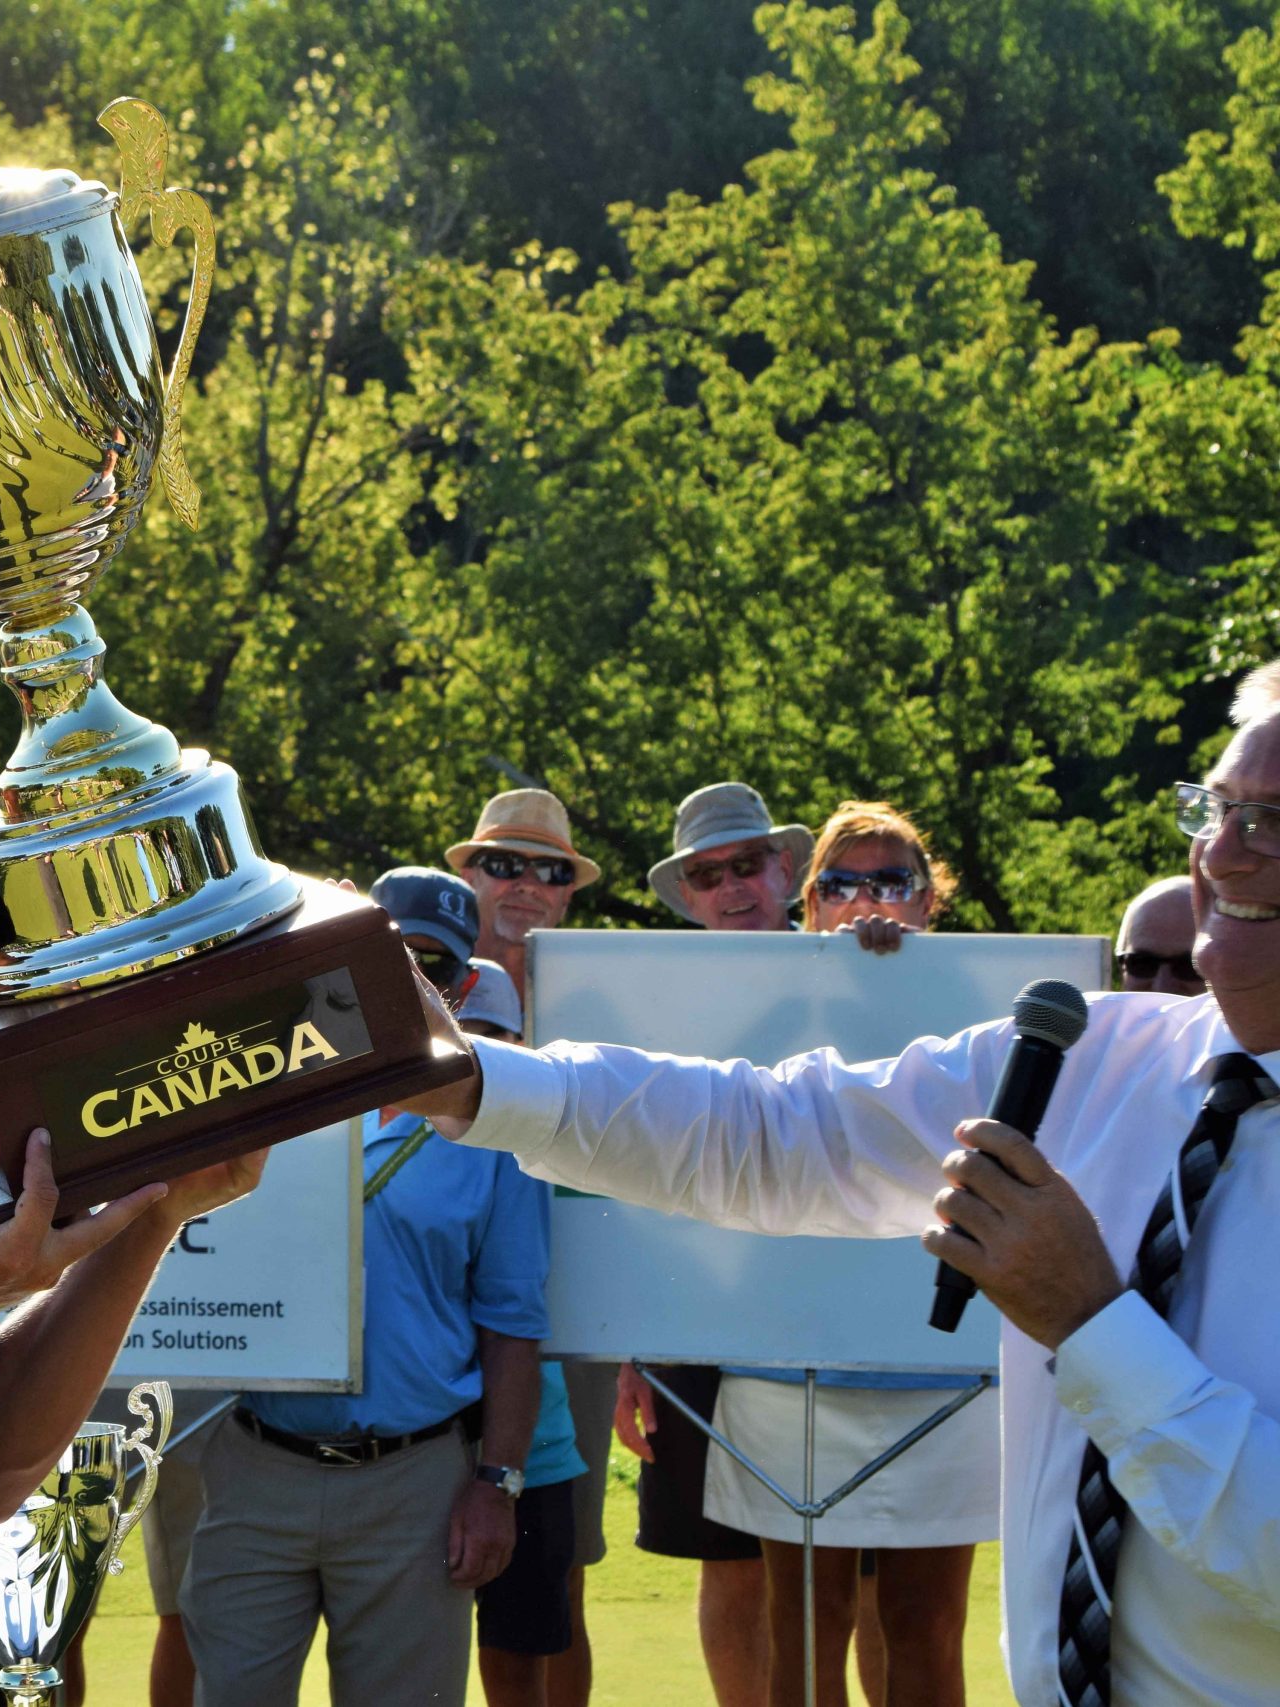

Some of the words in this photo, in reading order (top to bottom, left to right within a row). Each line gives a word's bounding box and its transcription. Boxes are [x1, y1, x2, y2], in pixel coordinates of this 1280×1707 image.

[156, 1034, 244, 1076] COUPE
[81, 1021, 341, 1139] CANADA
[152, 1330, 248, 1351] Solutions
